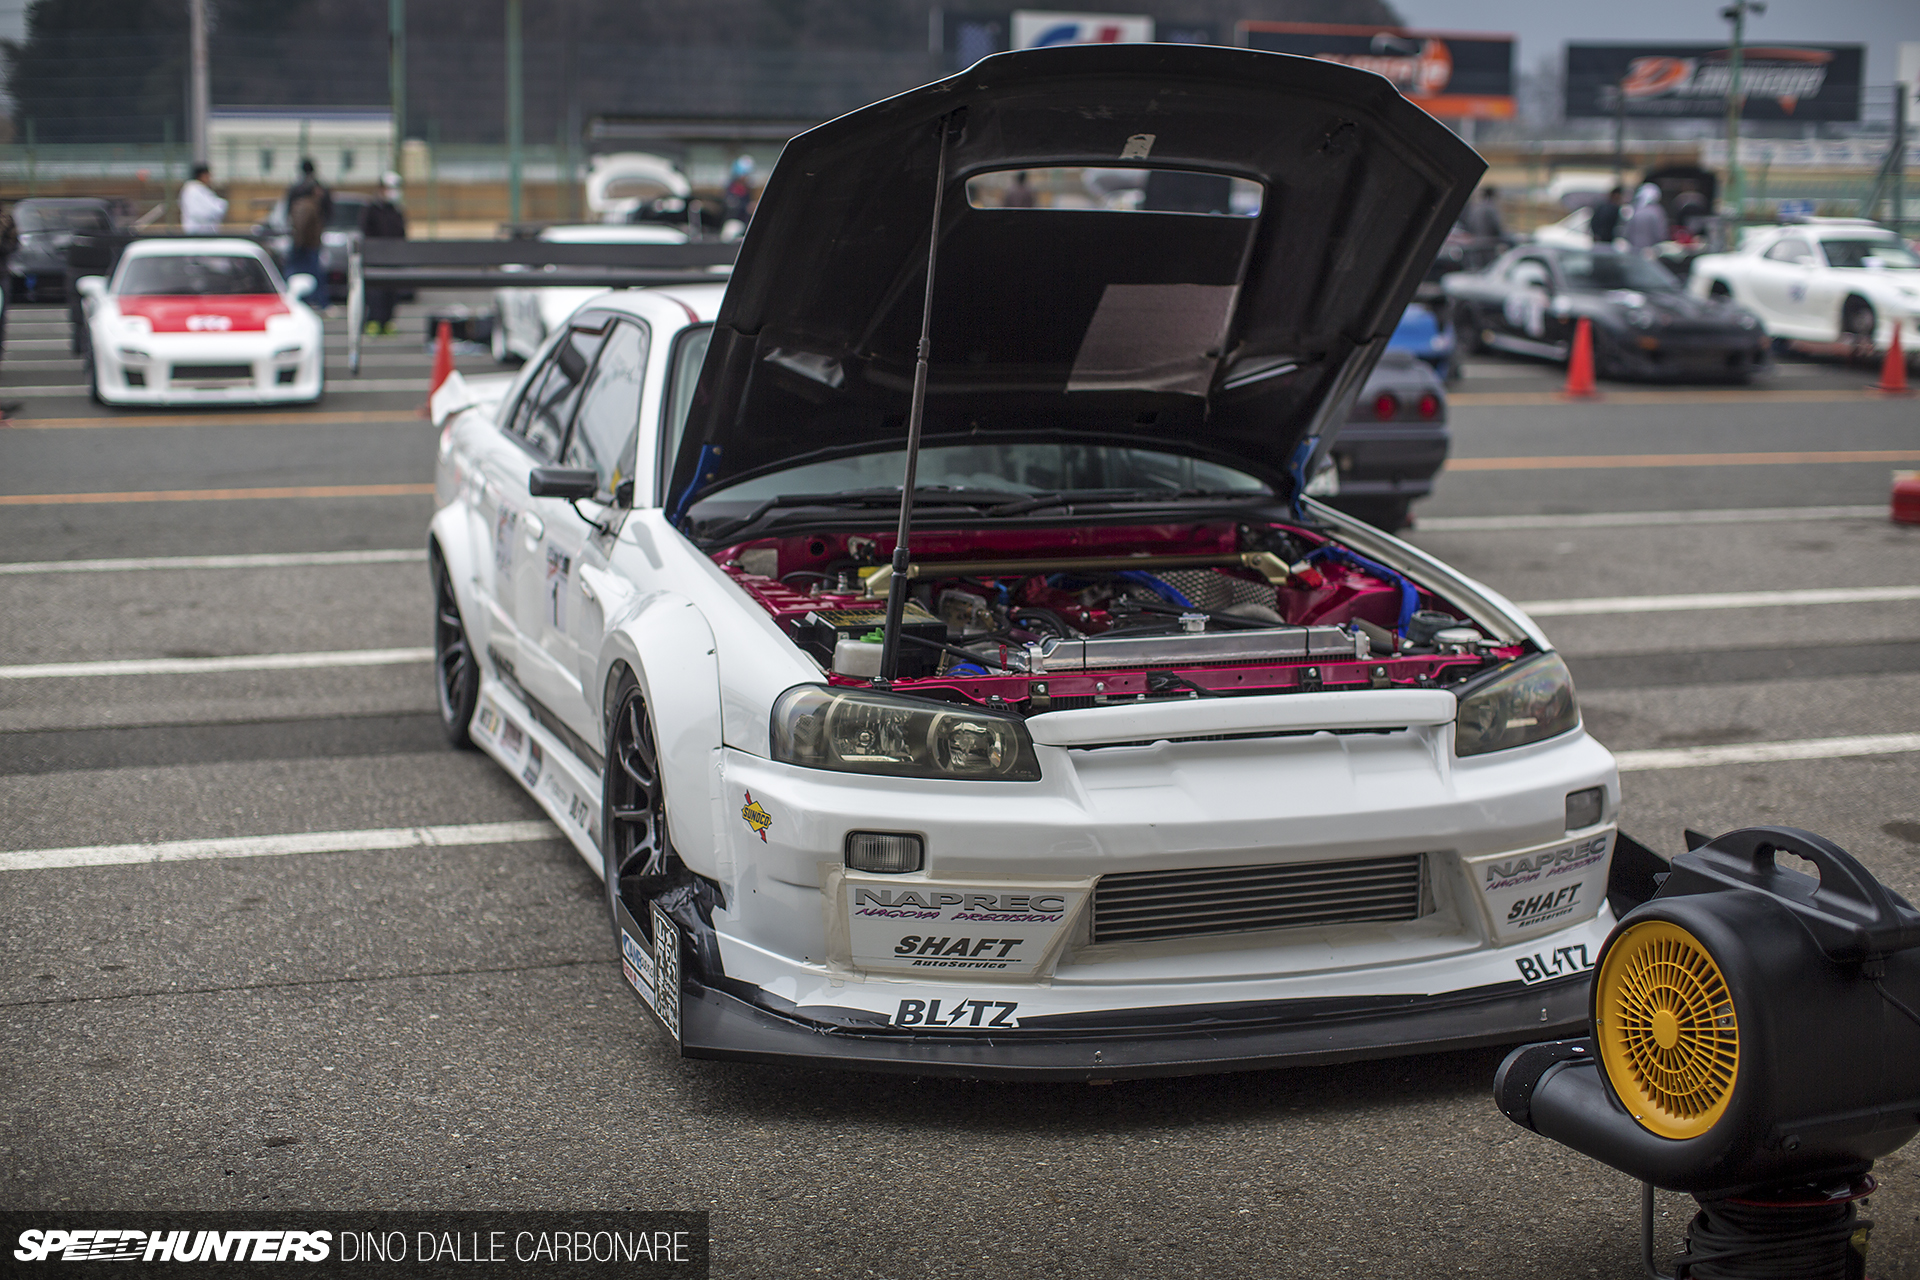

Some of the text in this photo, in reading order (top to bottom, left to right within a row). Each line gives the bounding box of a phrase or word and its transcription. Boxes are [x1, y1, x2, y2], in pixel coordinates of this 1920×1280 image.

[743, 806, 770, 827] SUNOCO
[1487, 836, 1607, 882] NAPREC
[855, 888, 1065, 913] NAPREC
[1507, 882, 1583, 920] SHAFT
[855, 908, 1064, 923] NAGOYA PRECISION
[894, 935, 1024, 958] SHAFT
[912, 959, 1007, 969] AutoService
[1515, 943, 1597, 982] BLITZ
[895, 997, 1019, 1028] BLITZ
